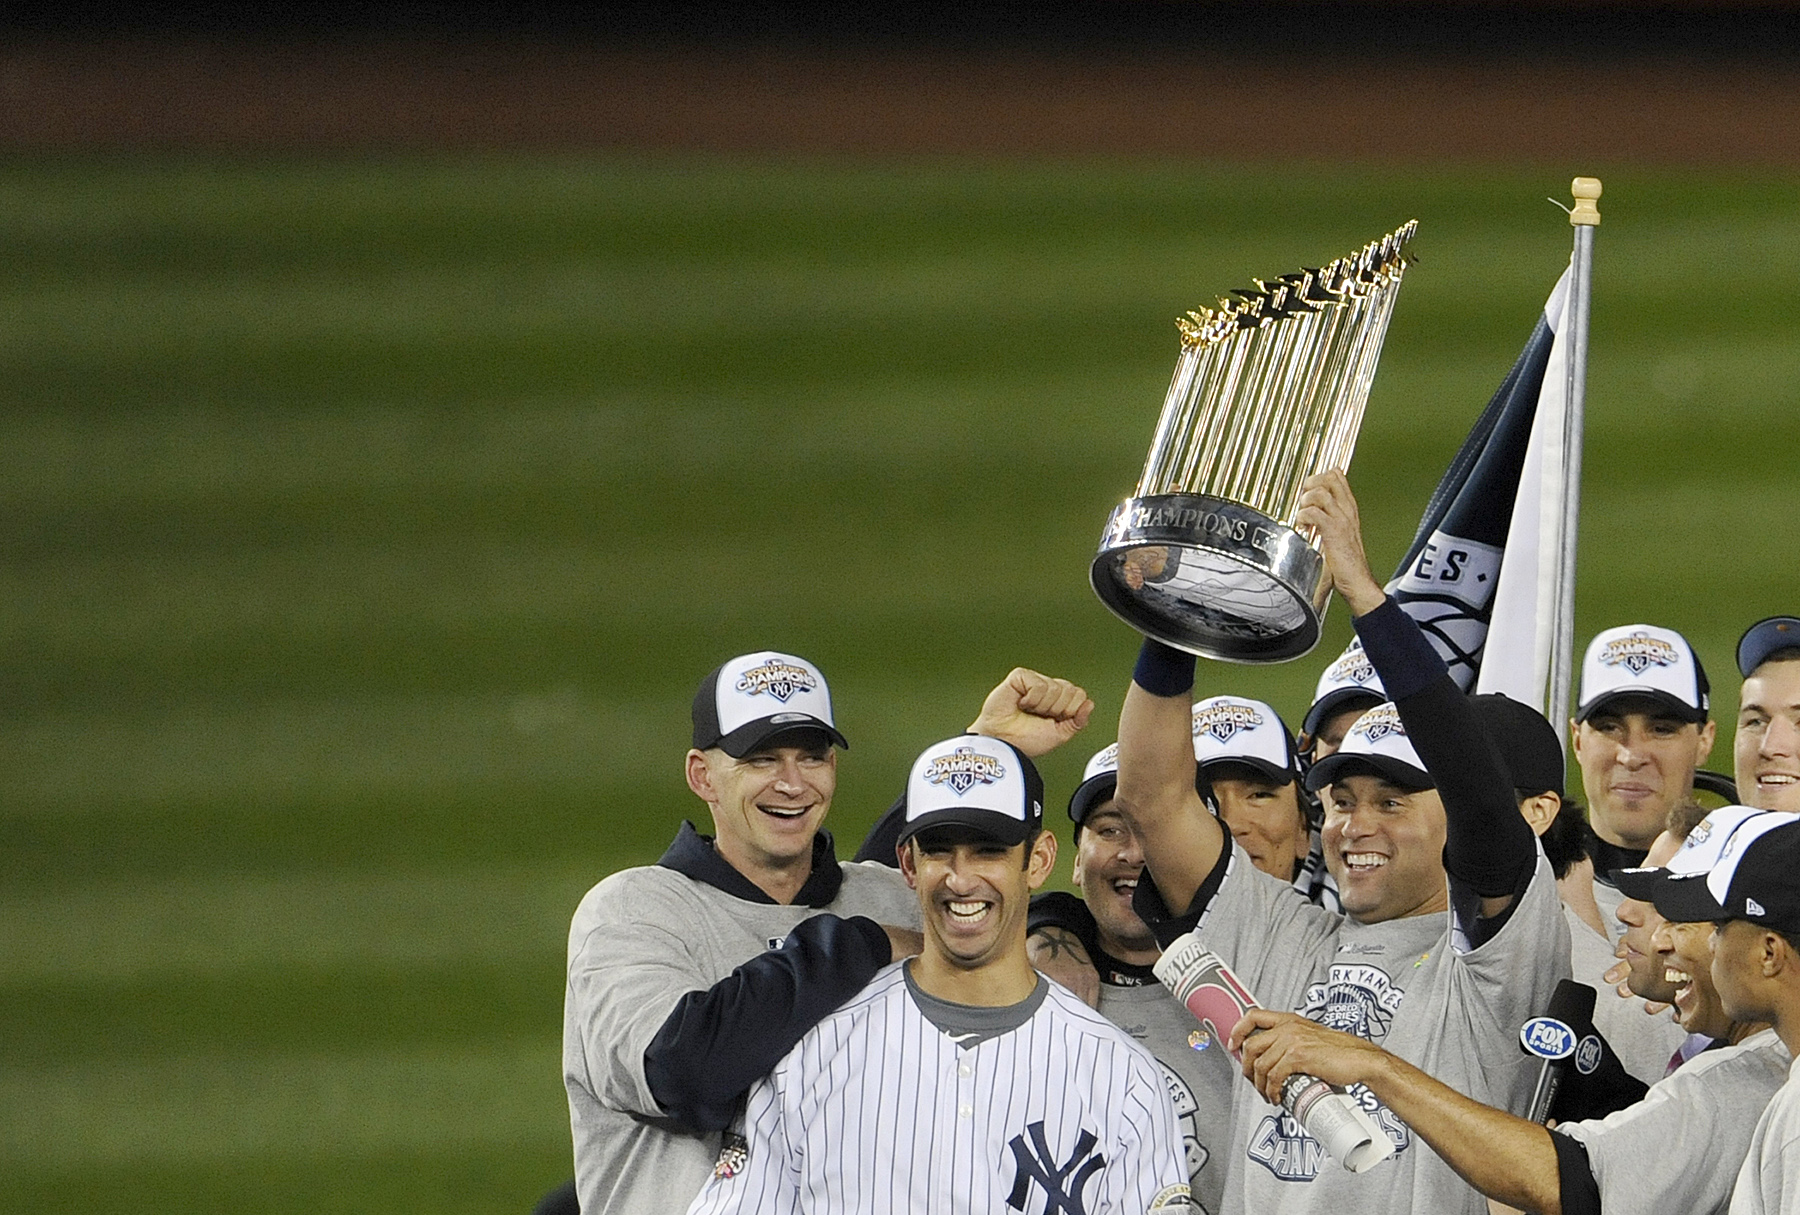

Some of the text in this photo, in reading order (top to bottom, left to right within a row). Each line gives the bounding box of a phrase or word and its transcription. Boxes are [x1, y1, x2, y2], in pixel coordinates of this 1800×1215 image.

[1130, 508, 1248, 542] CHAMPIONS
[1599, 643, 1678, 662] CHAMPIONS
[736, 669, 816, 691] CHAMPIONS
[924, 760, 1004, 778] CHAMPIONS
[1528, 1038, 1563, 1055] SPORTS
[1530, 1022, 1568, 1050] FOX
[1580, 1040, 1599, 1064] FOX
